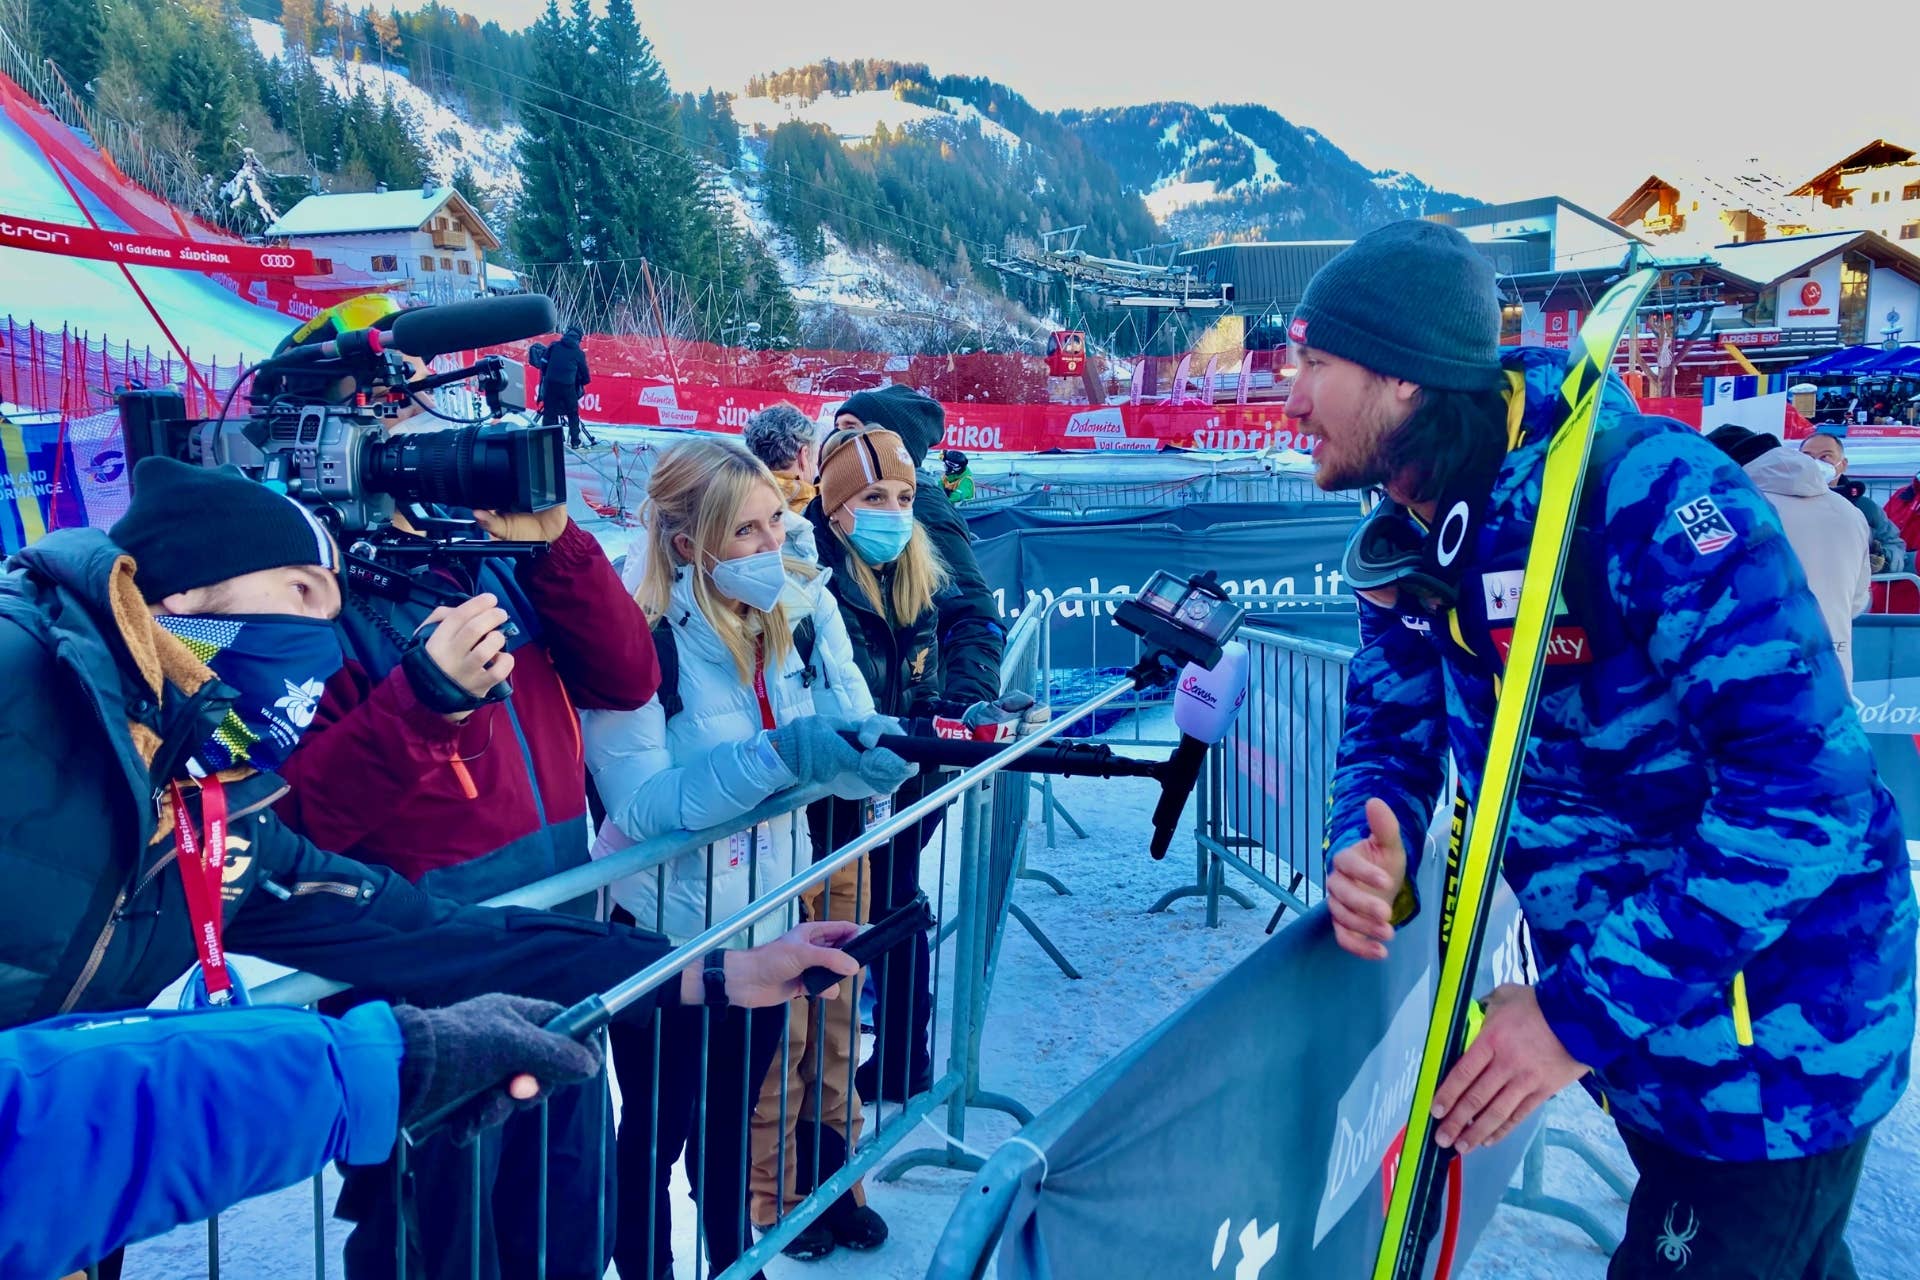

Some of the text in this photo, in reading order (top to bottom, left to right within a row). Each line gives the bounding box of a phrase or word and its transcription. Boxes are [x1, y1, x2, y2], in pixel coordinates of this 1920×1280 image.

[108, 241, 171, 258] al Gardena
[1761, 333, 1779, 343] SKI
[1070, 418, 1121, 434] Dolomites
[19, 470, 47, 485] AND
[261, 707, 273, 720] VAL
